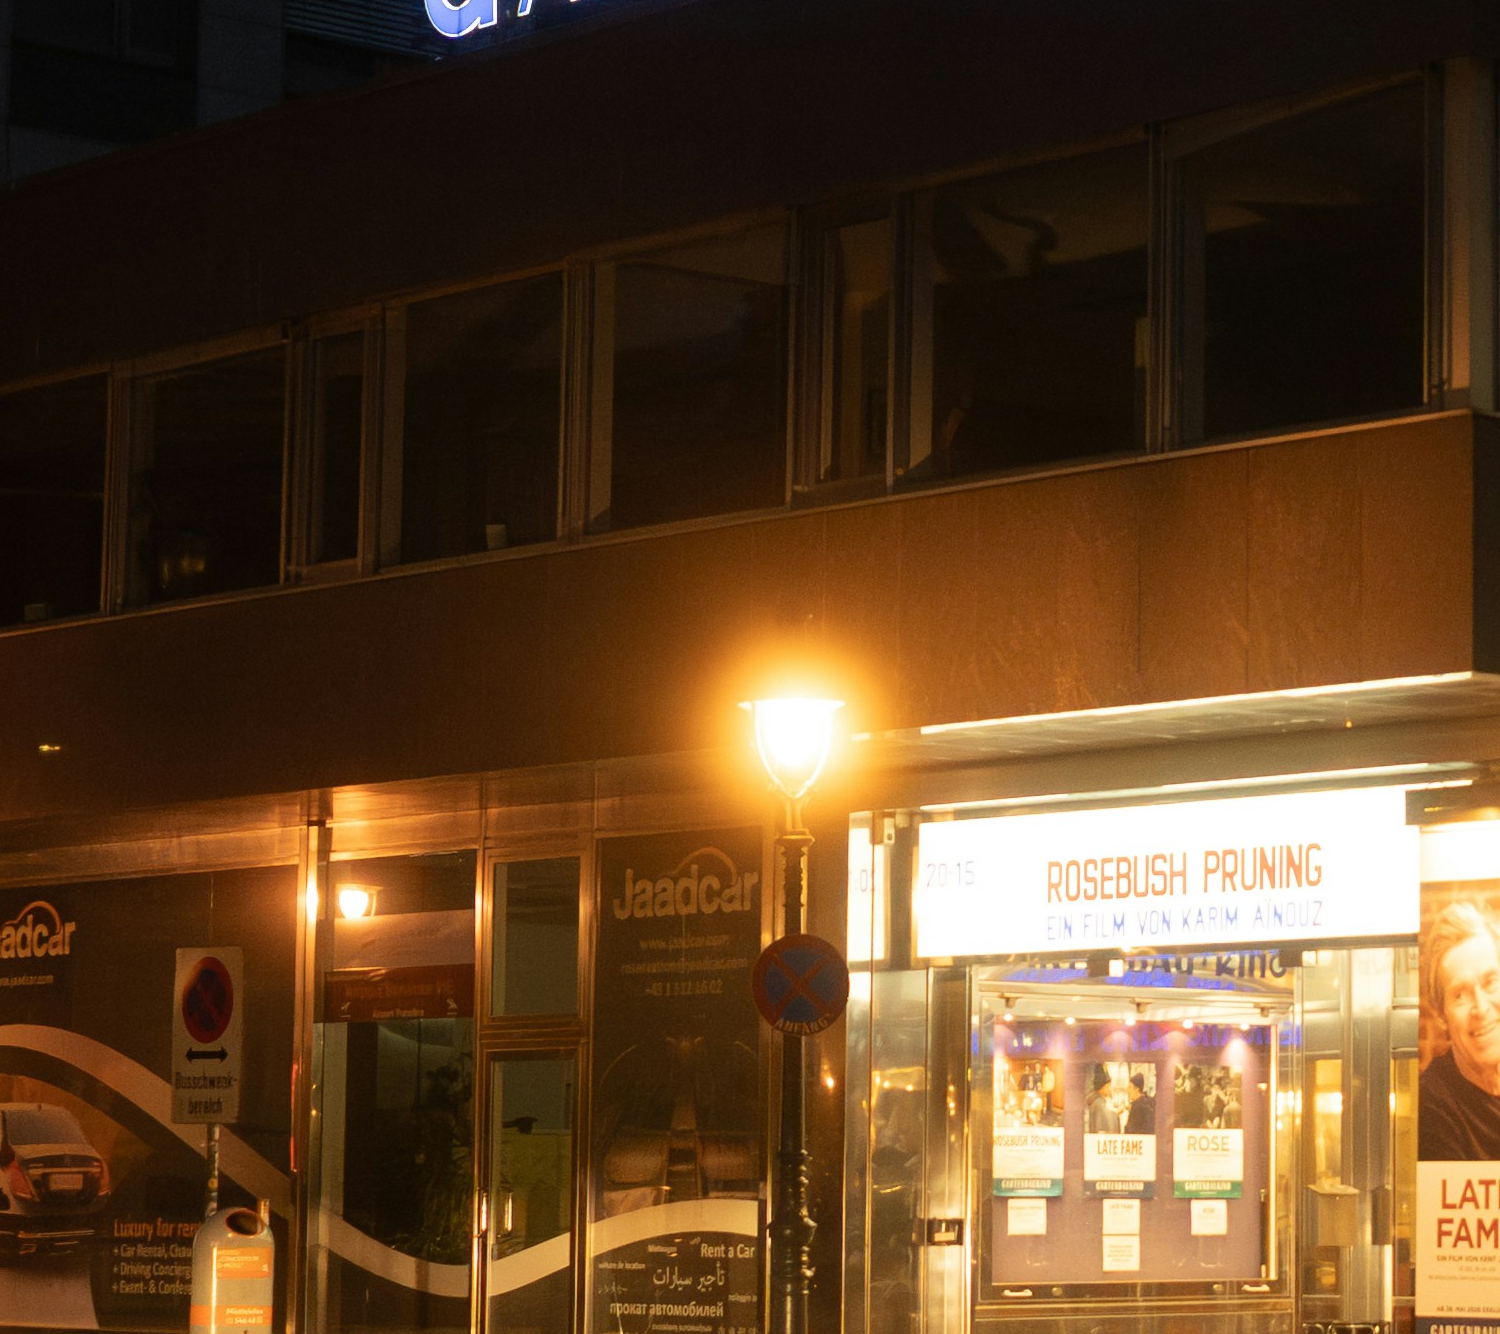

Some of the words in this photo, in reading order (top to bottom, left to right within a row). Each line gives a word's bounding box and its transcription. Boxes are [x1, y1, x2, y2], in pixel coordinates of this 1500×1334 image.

[1046, 851, 1188, 904] ROSEBUSH
[1203, 842, 1323, 895] PRUNING
[613, 864, 759, 919] Jaadcar
[1046, 913, 1073, 941] EIN
[1083, 910, 1126, 939] FILM
[1136, 907, 1172, 936] VON
[1182, 904, 1239, 933] KARIM
[775, 1012, 832, 1035] ANFANG
[188, 1098, 223, 1115] bereich
[1097, 1140, 1118, 1155] LATE
[1120, 1140, 1143, 1156] FAME
[1187, 1135, 1230, 1152] ROSE
[113, 1218, 154, 1241] Luxury
[157, 1217, 175, 1237] for
[120, 1244, 136, 1257] Car
[701, 1243, 726, 1258] Rent
[728, 1247, 735, 1258] a
[737, 1243, 756, 1258] Car
[120, 1262, 150, 1279] Driving
[609, 1302, 648, 1316] прокат
[649, 1301, 724, 1318] автомобилей
